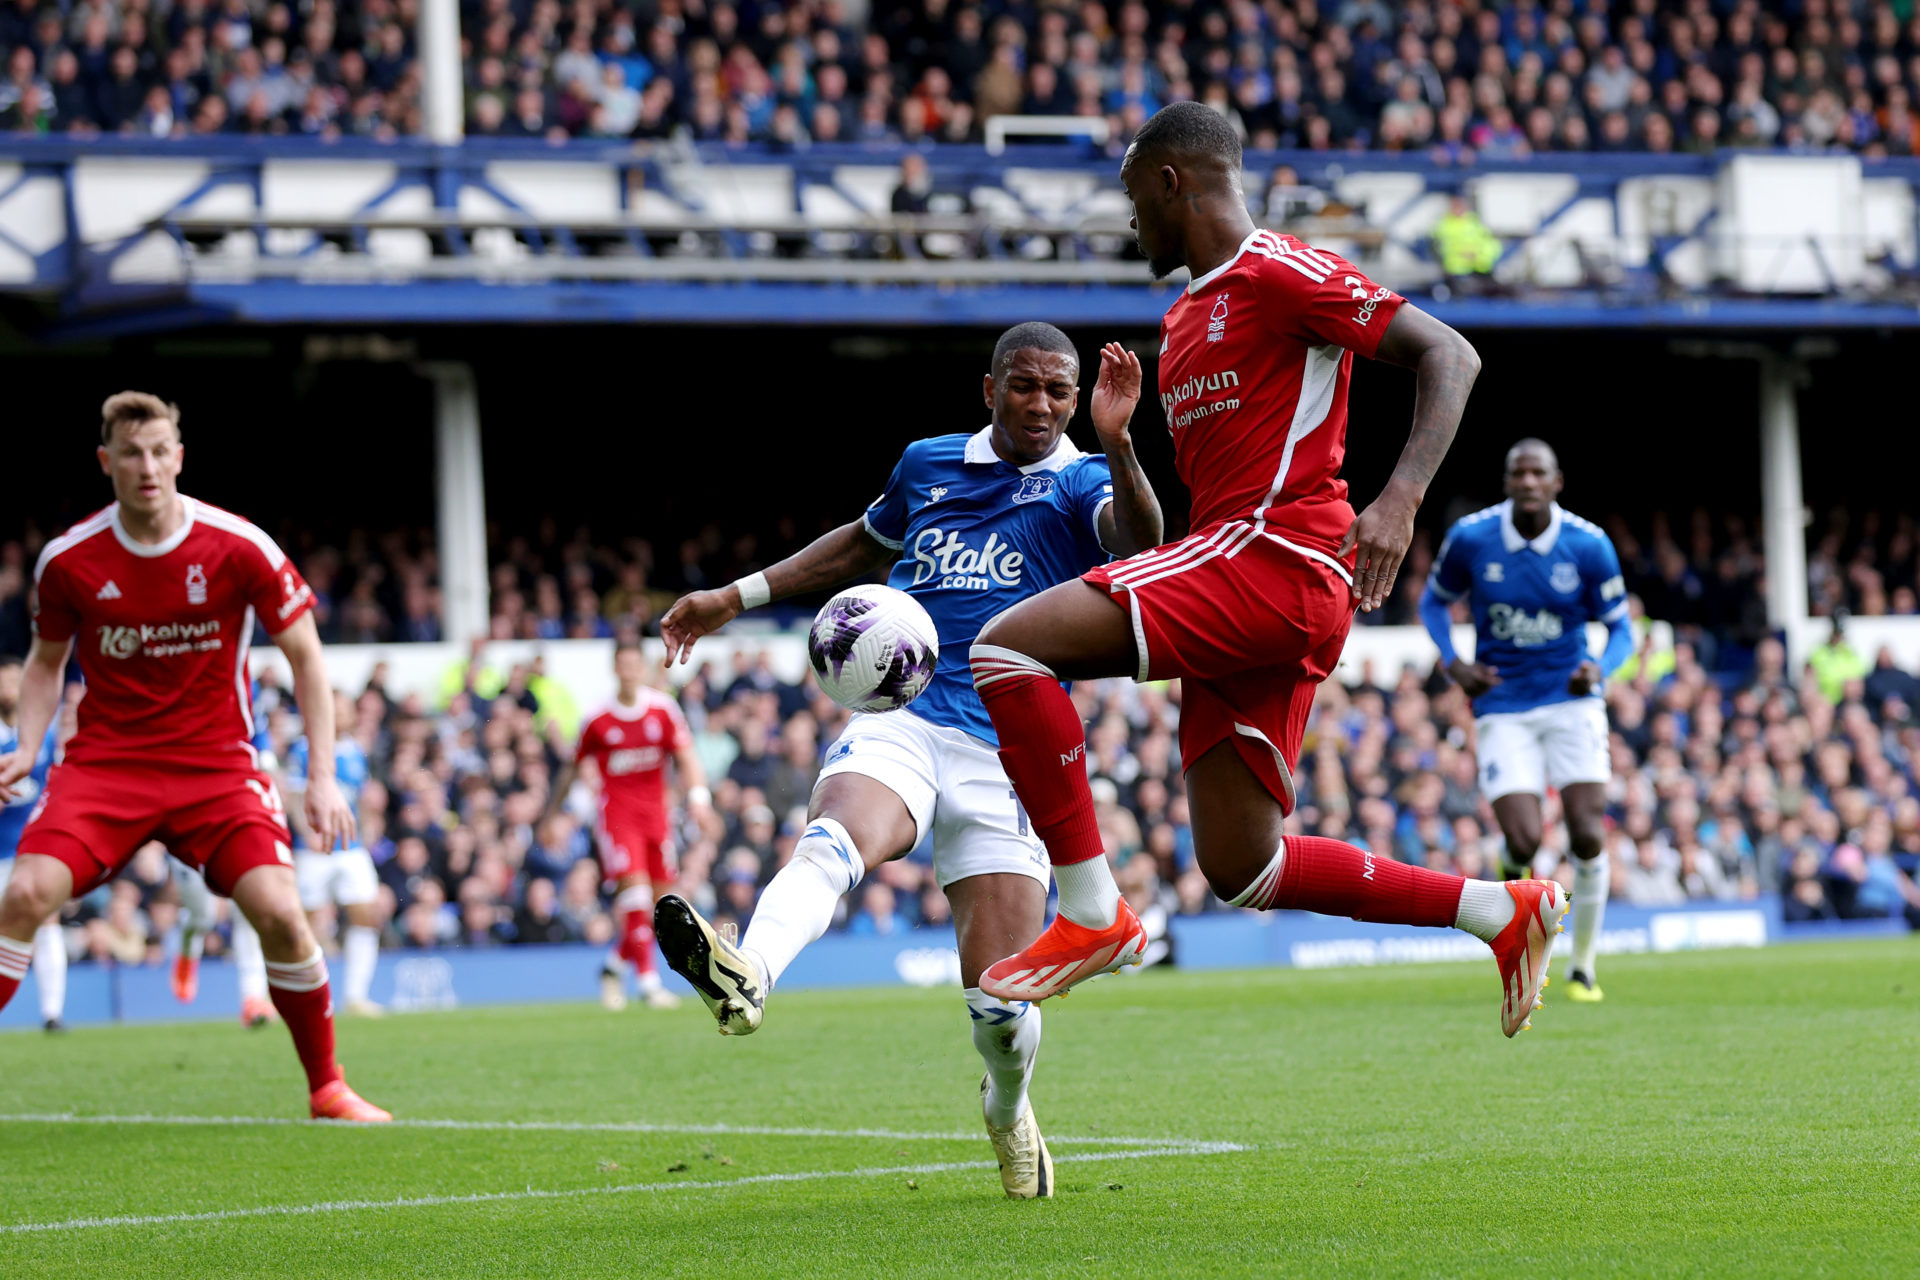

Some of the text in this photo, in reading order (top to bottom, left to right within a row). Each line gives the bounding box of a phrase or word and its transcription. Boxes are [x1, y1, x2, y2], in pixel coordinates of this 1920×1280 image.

[1174, 398, 1240, 430] kaiyun.com
[912, 527, 1024, 586] Stake
[936, 575, 989, 591] .com
